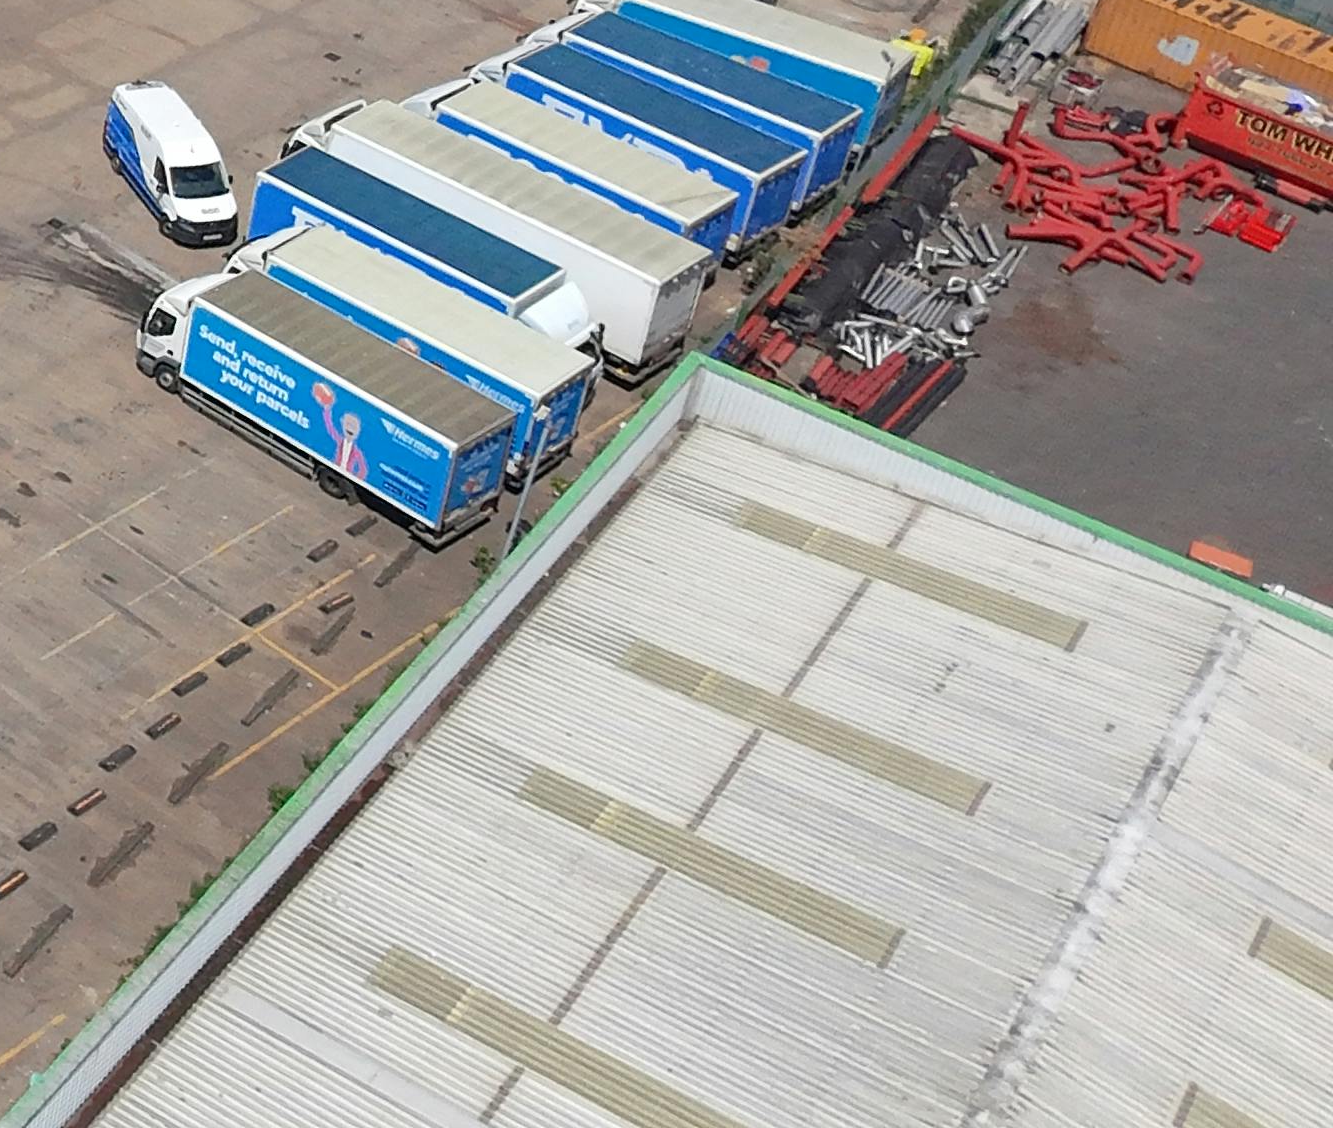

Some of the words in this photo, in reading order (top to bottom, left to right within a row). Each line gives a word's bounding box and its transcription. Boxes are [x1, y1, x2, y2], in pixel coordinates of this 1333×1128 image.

[1236, 109, 1288, 143] TOM
[1291, 131, 1333, 165] WH
[198, 323, 239, 359] Send,
[241, 350, 297, 390] receive
[212, 350, 242, 374] and
[242, 367, 290, 402] return
[219, 369, 255, 396] your
[255, 390, 311, 430] parcels
[393, 427, 441, 461] Hermes
